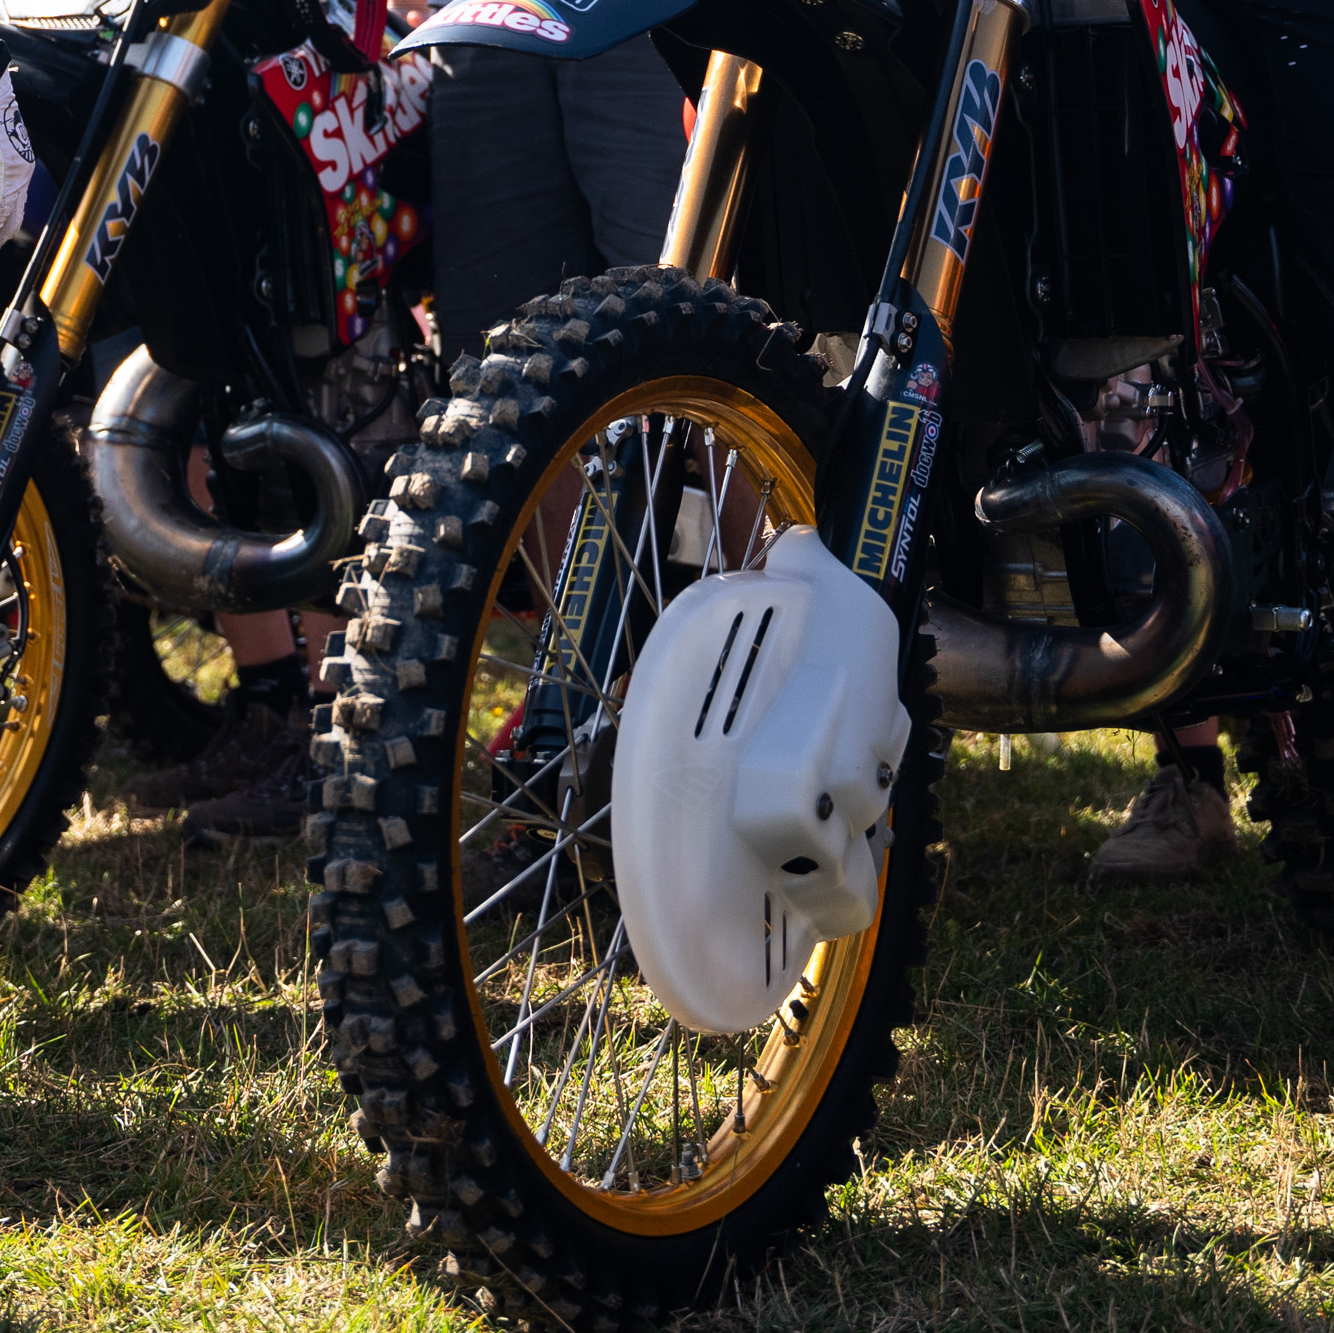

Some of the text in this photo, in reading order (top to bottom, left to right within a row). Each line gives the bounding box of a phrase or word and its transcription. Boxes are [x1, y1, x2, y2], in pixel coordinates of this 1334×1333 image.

[902, 390, 929, 404] CMSNL
[856, 405, 916, 577] MICHELIN
[911, 408, 943, 489] docwob
[891, 492, 922, 584] SYNTOL
